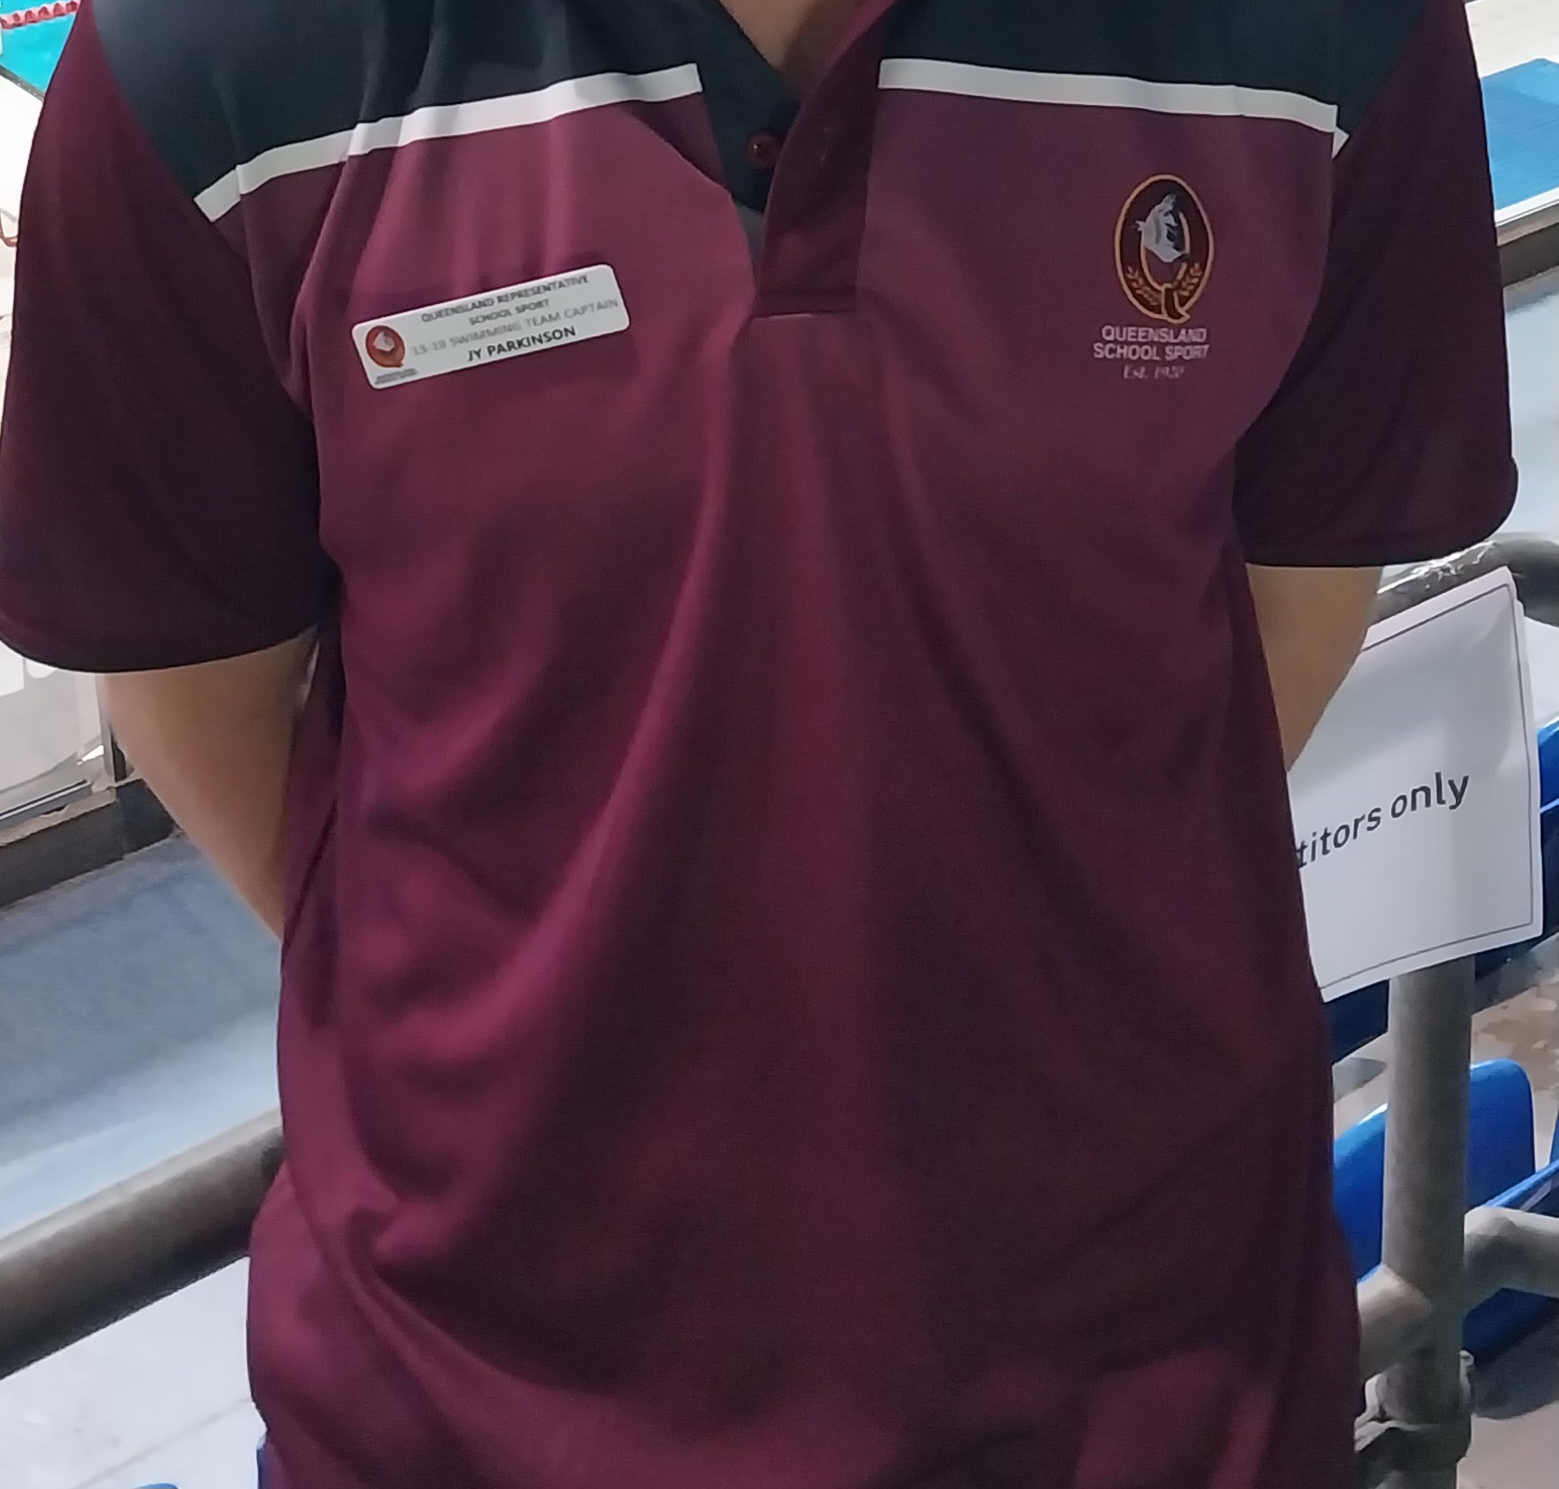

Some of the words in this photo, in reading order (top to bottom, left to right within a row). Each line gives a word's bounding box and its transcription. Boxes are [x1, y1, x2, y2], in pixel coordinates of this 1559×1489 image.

[420, 297, 495, 323] QUEENSLAND
[496, 274, 589, 304] REPRESENTATIVE
[468, 309, 513, 326] SCHOOL
[515, 298, 550, 314] SPORT
[448, 321, 522, 347] SWIMMING
[524, 311, 562, 328] TEAM
[564, 298, 619, 319] CAPTAIN
[1101, 324, 1208, 343] QUEENSLAND
[467, 348, 482, 362] JY
[486, 325, 577, 357] PARKINSON
[1093, 342, 1162, 361] SCHOOL
[1164, 344, 1211, 361] SPORT
[1390, 771, 1470, 818] only
